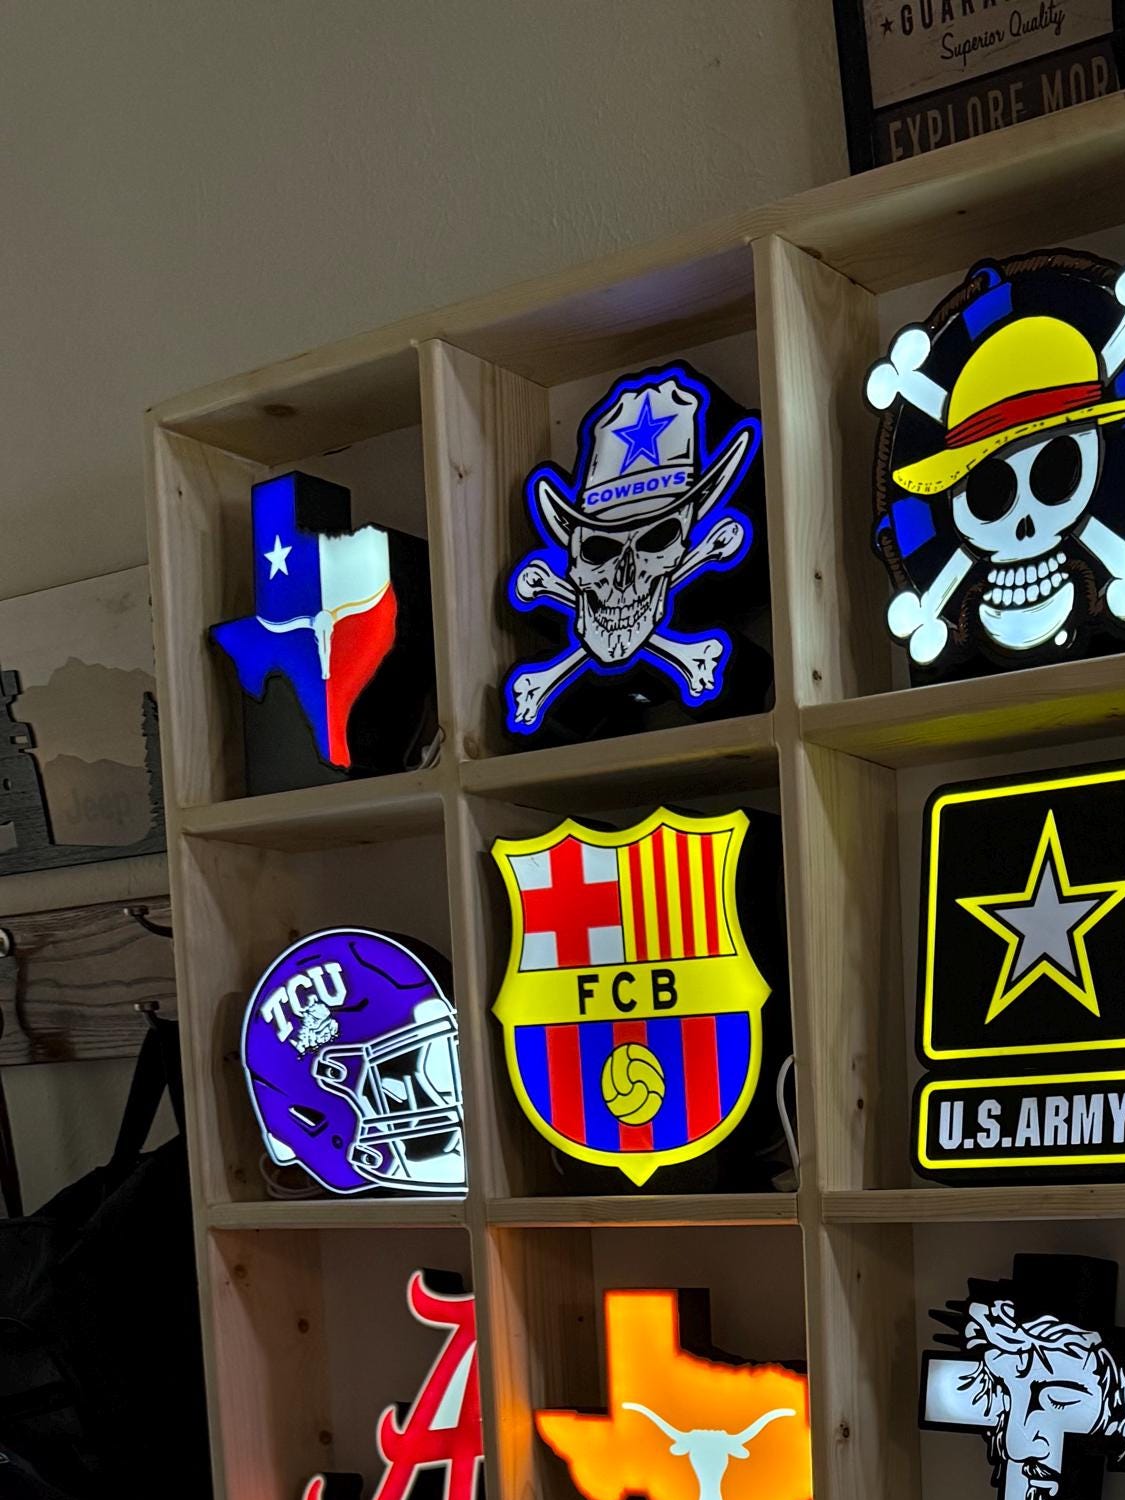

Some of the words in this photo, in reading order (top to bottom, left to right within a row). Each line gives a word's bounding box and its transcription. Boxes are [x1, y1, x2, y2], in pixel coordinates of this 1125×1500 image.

[940, 28, 1004, 67] Superior
[1009, 4, 1065, 36] Quality
[586, 471, 687, 508] COWBOYS
[261, 962, 347, 1043] TCU
